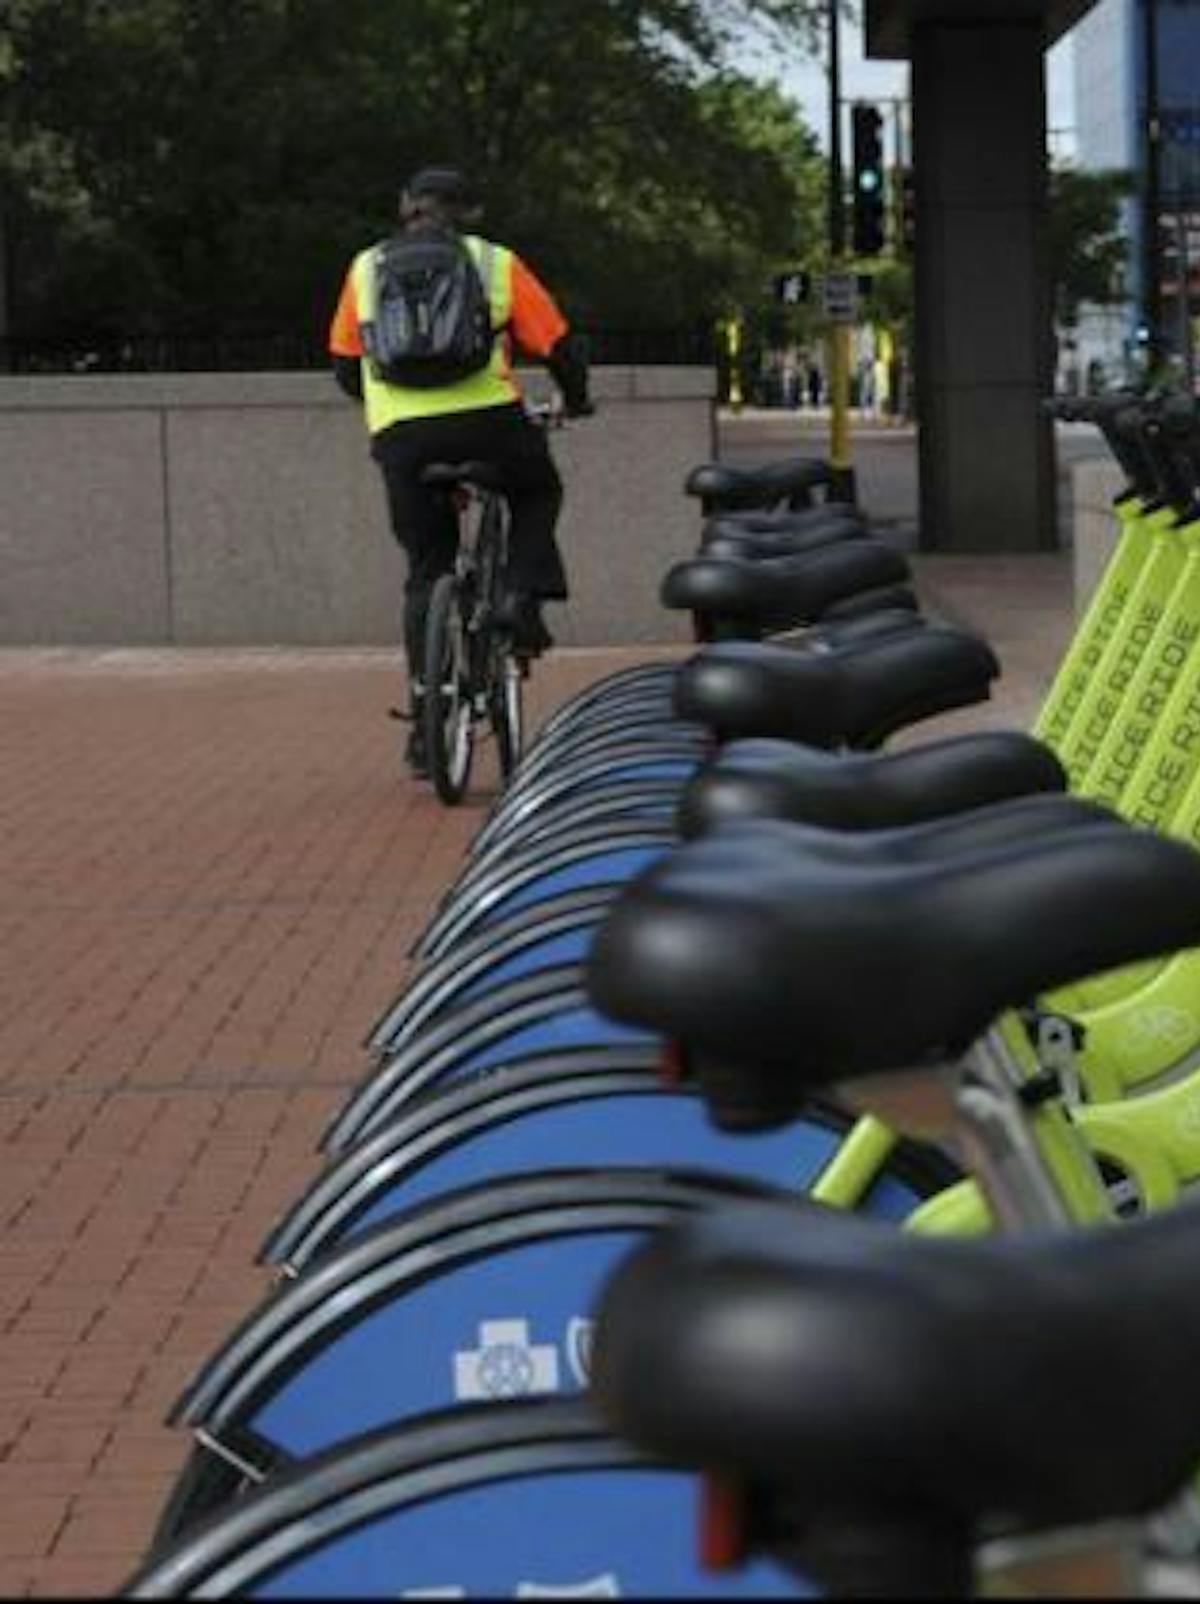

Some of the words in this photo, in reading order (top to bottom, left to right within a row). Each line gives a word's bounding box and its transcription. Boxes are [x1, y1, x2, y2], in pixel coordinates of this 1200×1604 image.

[1108, 602, 1164, 692] RIDE
[1099, 722, 1151, 795] ICE
[1138, 617, 1200, 719] RIDE
[1134, 755, 1185, 825] ICE
